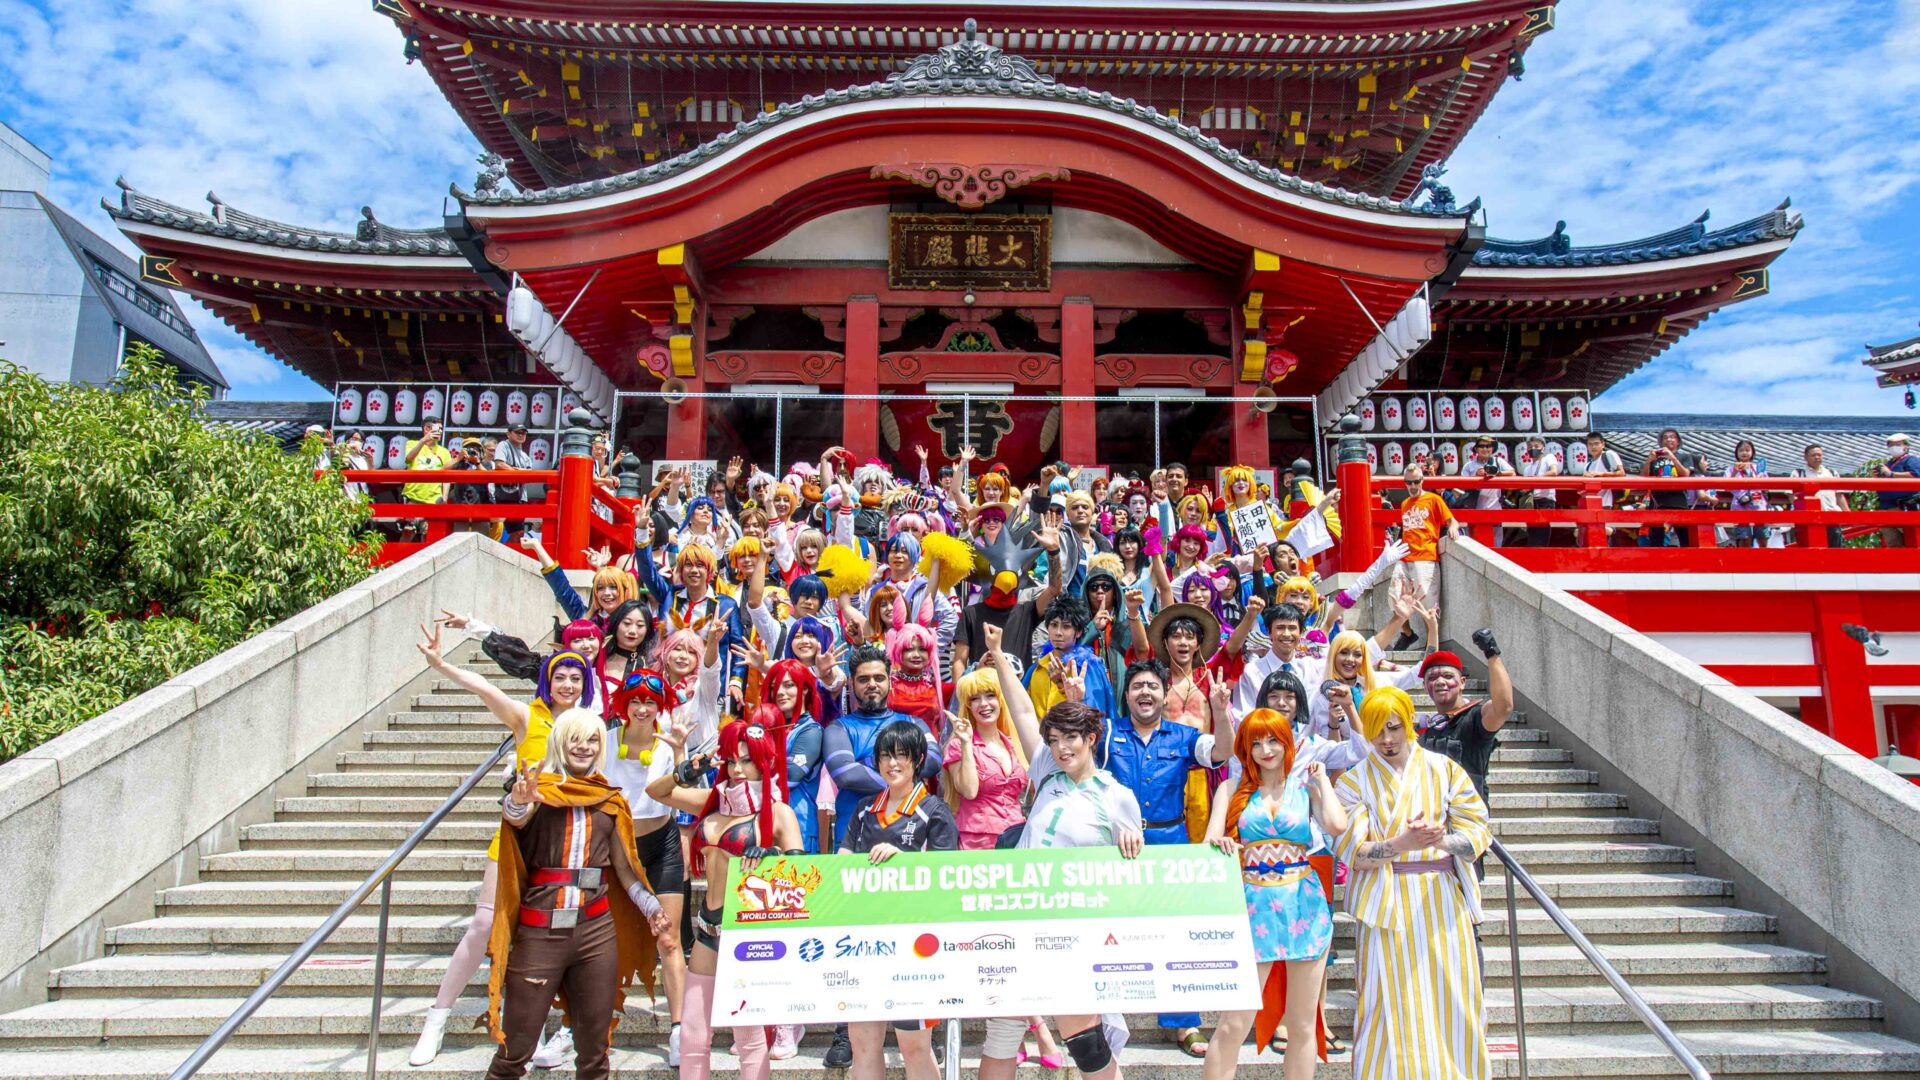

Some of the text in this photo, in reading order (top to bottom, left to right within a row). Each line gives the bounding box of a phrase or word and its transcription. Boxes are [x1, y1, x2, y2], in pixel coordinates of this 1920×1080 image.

[1250, 505, 1267, 532] 田中
[1045, 807, 1064, 836] 1
[840, 857, 1228, 894] WORLD COSPLAY SUMMIT 2023
[746, 875, 806, 909] WCS
[961, 890, 1111, 912] 世界コスプレサミット
[741, 912, 767, 921] WORLD
[768, 911, 793, 920] COSPLAY
[1188, 929, 1235, 941] brother
[747, 943, 774, 951] OFFICIAL
[746, 950, 774, 959] SPONSOR
[823, 970, 849, 980] small
[978, 965, 1017, 975] Rakuten
[892, 973, 945, 982] dwango
[978, 977, 1007, 986] チケット
[1172, 982, 1238, 994] MyAnimeList
